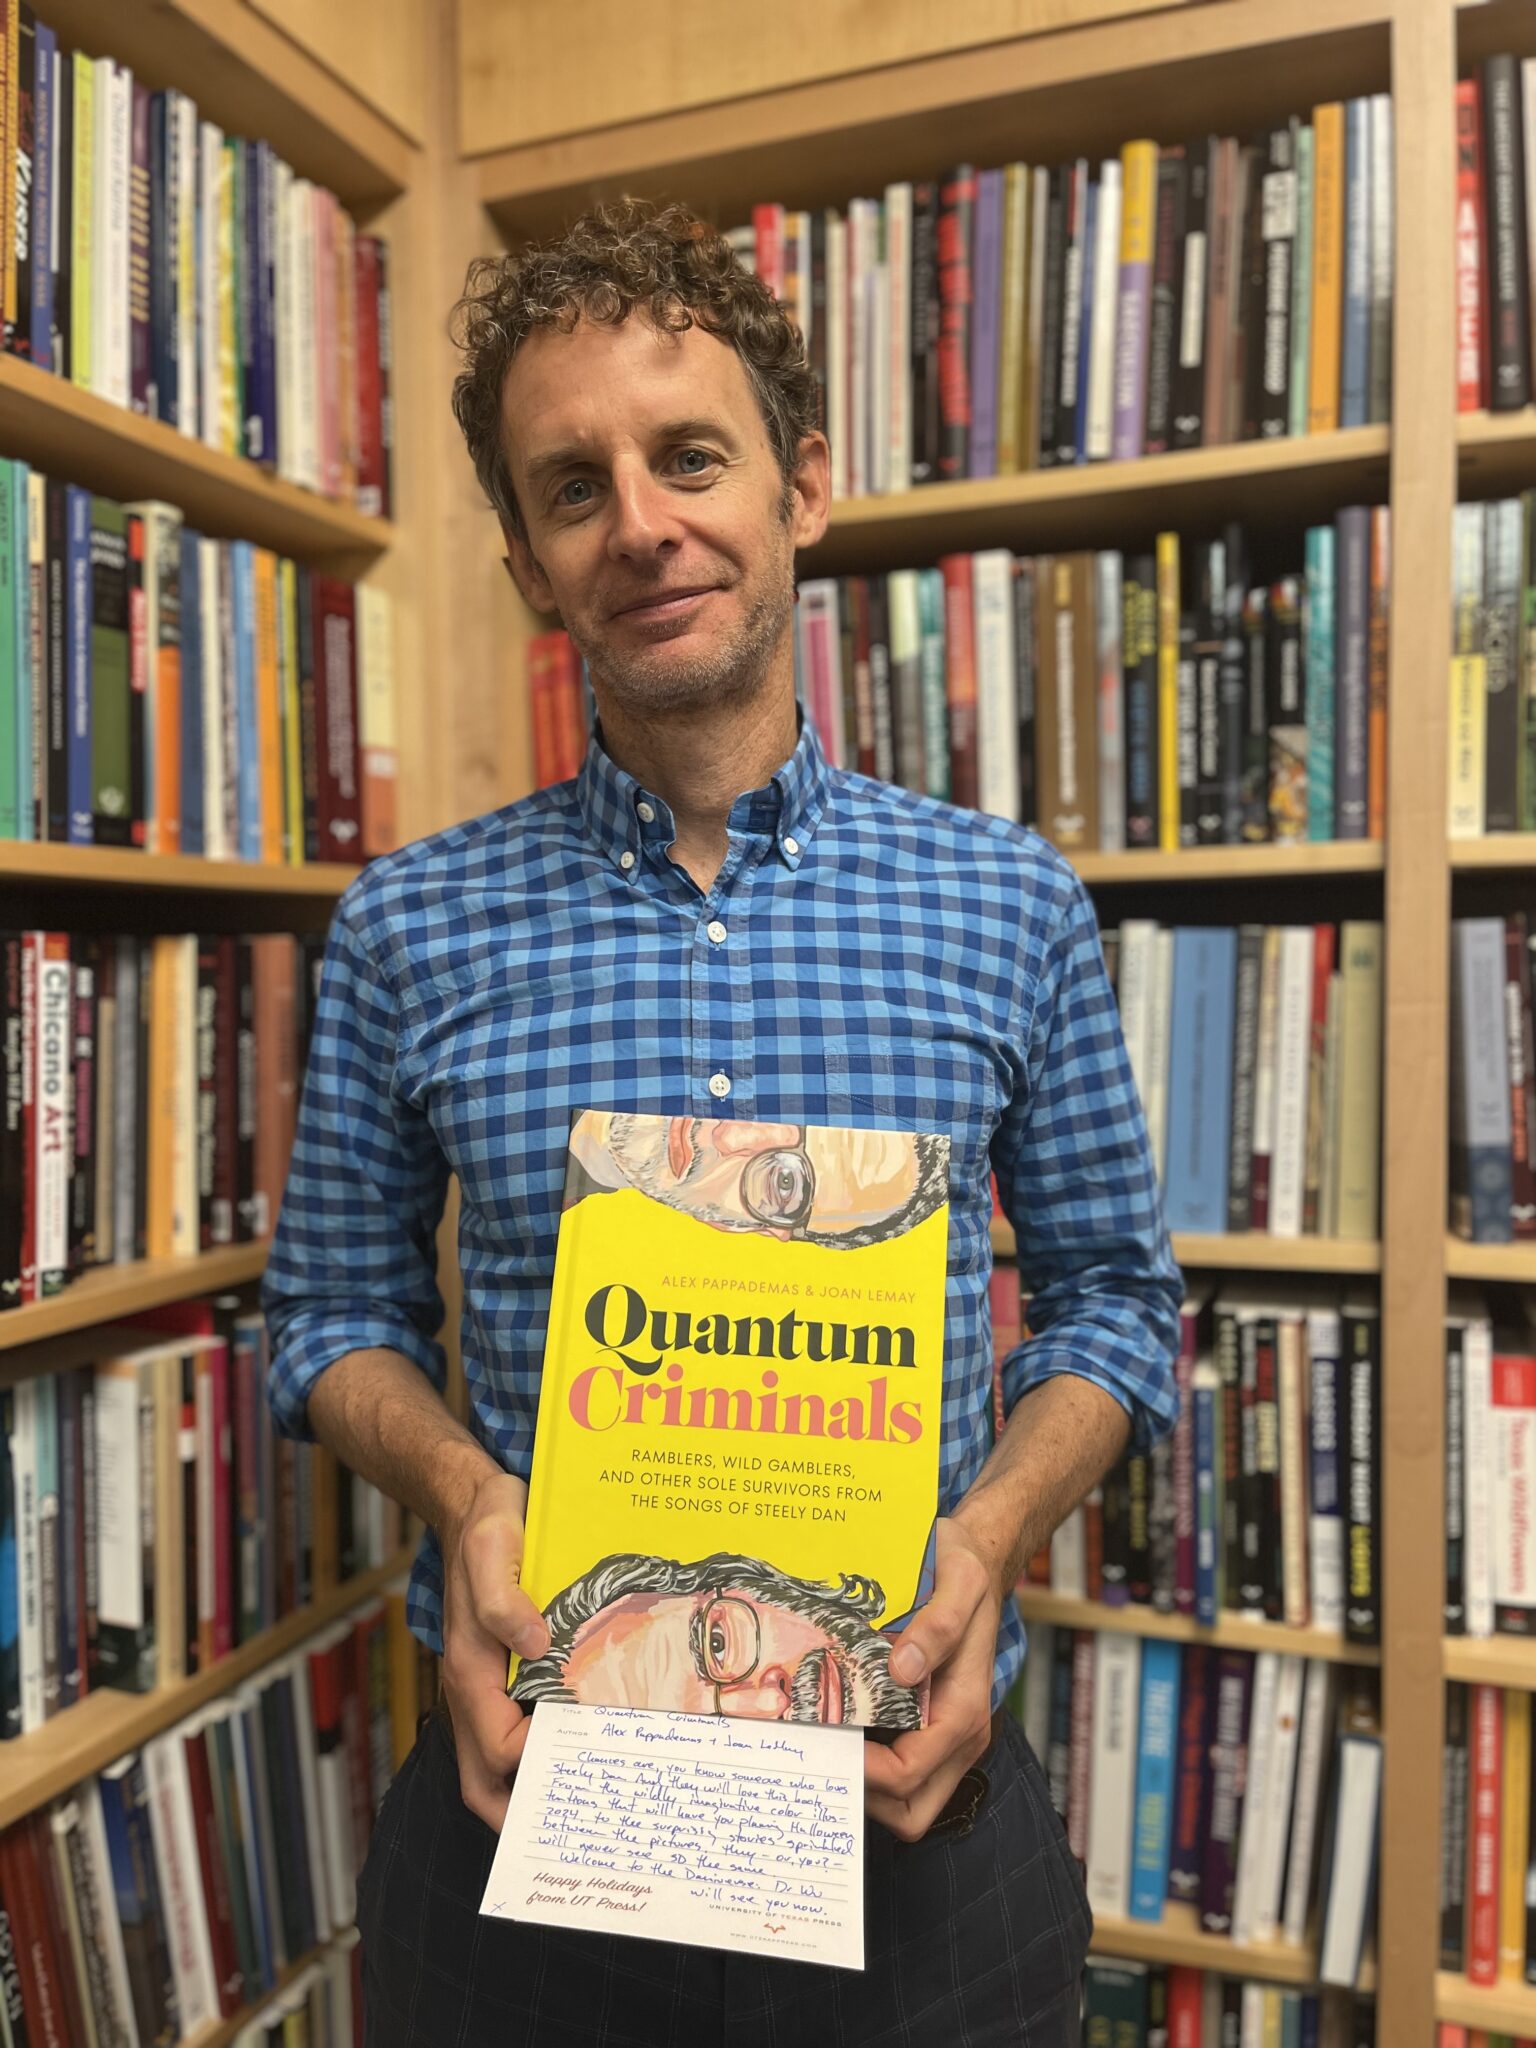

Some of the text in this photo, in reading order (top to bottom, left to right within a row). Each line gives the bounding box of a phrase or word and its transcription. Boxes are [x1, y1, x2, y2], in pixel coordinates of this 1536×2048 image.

[43, 967, 67, 1155] Chicano Art
[661, 1275, 917, 1304] ALEX PAPPADEMAS & JOAN LEMAY
[584, 1283, 919, 1376] Quantum
[568, 1363, 923, 1445] Criminals
[631, 1449, 857, 1480] RAMBLERS, WILD GAMBLERS,
[599, 1469, 882, 1503] AND OTHER SOLE SURVIVORS FROM
[631, 1493, 847, 1523] THE SONGS OF STEELY DAN
[557, 1728, 588, 1736] AUTHOR
[594, 1706, 730, 1728] Quantum Criminals
[601, 1723, 628, 1737] Alex
[635, 1727, 702, 1743] Pappademas
[724, 1735, 752, 1749] Joan
[553, 1762, 593, 1786] Steely
[669, 1775, 699, 1798] they
[703, 1781, 729, 1795] will
[738, 1784, 759, 1798] love
[765, 1788, 788, 1802] this
[578, 1752, 625, 1767] Chances
[666, 1765, 686, 1777] you
[695, 1761, 725, 1779] know
[731, 1772, 782, 1786] someone
[789, 1776, 815, 1790] who
[825, 1779, 848, 1795] loves
[551, 1777, 590, 1791] From
[599, 1781, 621, 1796] the
[634, 1786, 677, 1809] wildly
[690, 1793, 760, 1814] imaginative
[771, 1804, 803, 1817] color
[595, 1812, 610, 1824] to
[620, 1815, 642, 1829] the
[729, 1831, 775, 1846] stories
[786, 1837, 855, 1856] sprinkled
[608, 1798, 637, 1813] that
[646, 1803, 670, 1816] will
[677, 1806, 705, 1820] have
[714, 1815, 734, 1830] you
[739, 1816, 784, 1840] planning
[791, 1822, 855, 1840] Halloween
[538, 1834, 568, 1848] will
[580, 1843, 621, 1854] never
[626, 1850, 652, 1859] see
[671, 1854, 686, 1865] SD
[696, 1855, 720, 1869] the
[543, 1816, 607, 1836] between
[612, 1828, 640, 1844] the
[722, 1844, 756, 1865] they
[799, 1857, 830, 1873] you?
[533, 1872, 653, 1898] Happy Holidays
[560, 1851, 616, 1870] Welcome
[627, 1860, 643, 1871] to
[651, 1863, 676, 1878] the
[801, 1885, 823, 1898] Wu
[526, 1891, 648, 1912] from UT Press!
[690, 1887, 828, 1916] will see you now.
[709, 1904, 761, 1916] UNIVERSITY
[780, 1914, 810, 1923] TEXAS
[813, 1919, 842, 1927] PRESS
